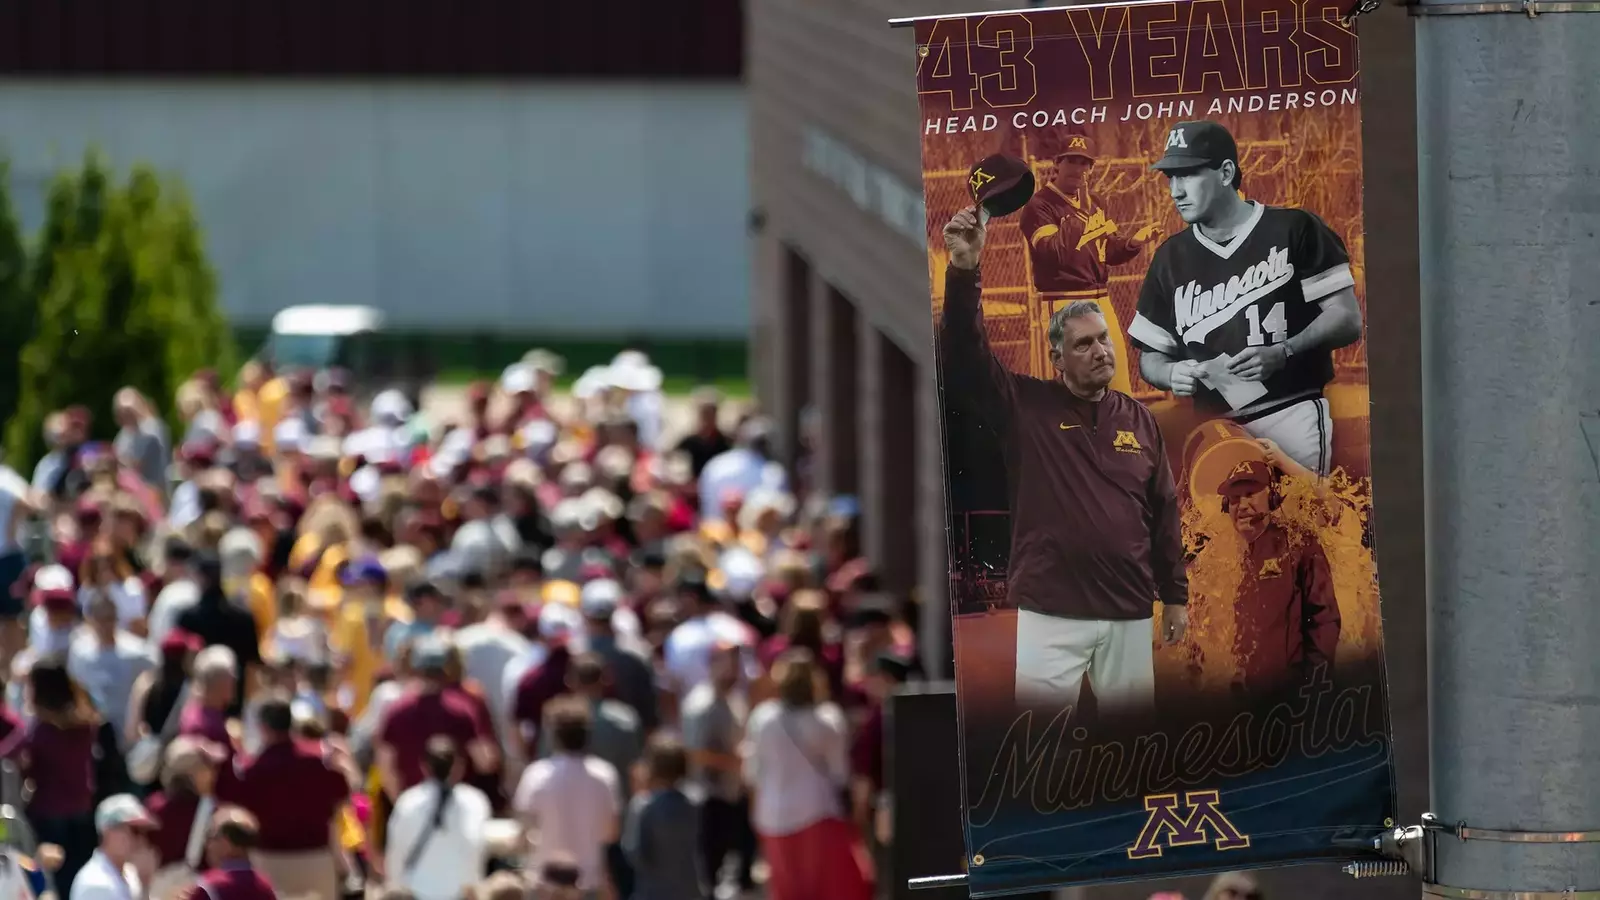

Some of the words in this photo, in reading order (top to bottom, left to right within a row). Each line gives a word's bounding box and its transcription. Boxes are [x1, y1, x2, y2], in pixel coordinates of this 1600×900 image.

[916, 13, 1036, 110] 43
[1066, 0, 1360, 100] YEARS
[926, 115, 998, 134] HEAD
[1013, 107, 1106, 129] COACH
[1120, 101, 1194, 122] JOHN
[1207, 88, 1358, 114] ANDERSON
[1174, 246, 1293, 337] Minnesota
[1246, 302, 1288, 346] 14
[968, 661, 1391, 828] Minnesota
[1127, 790, 1250, 859] M
